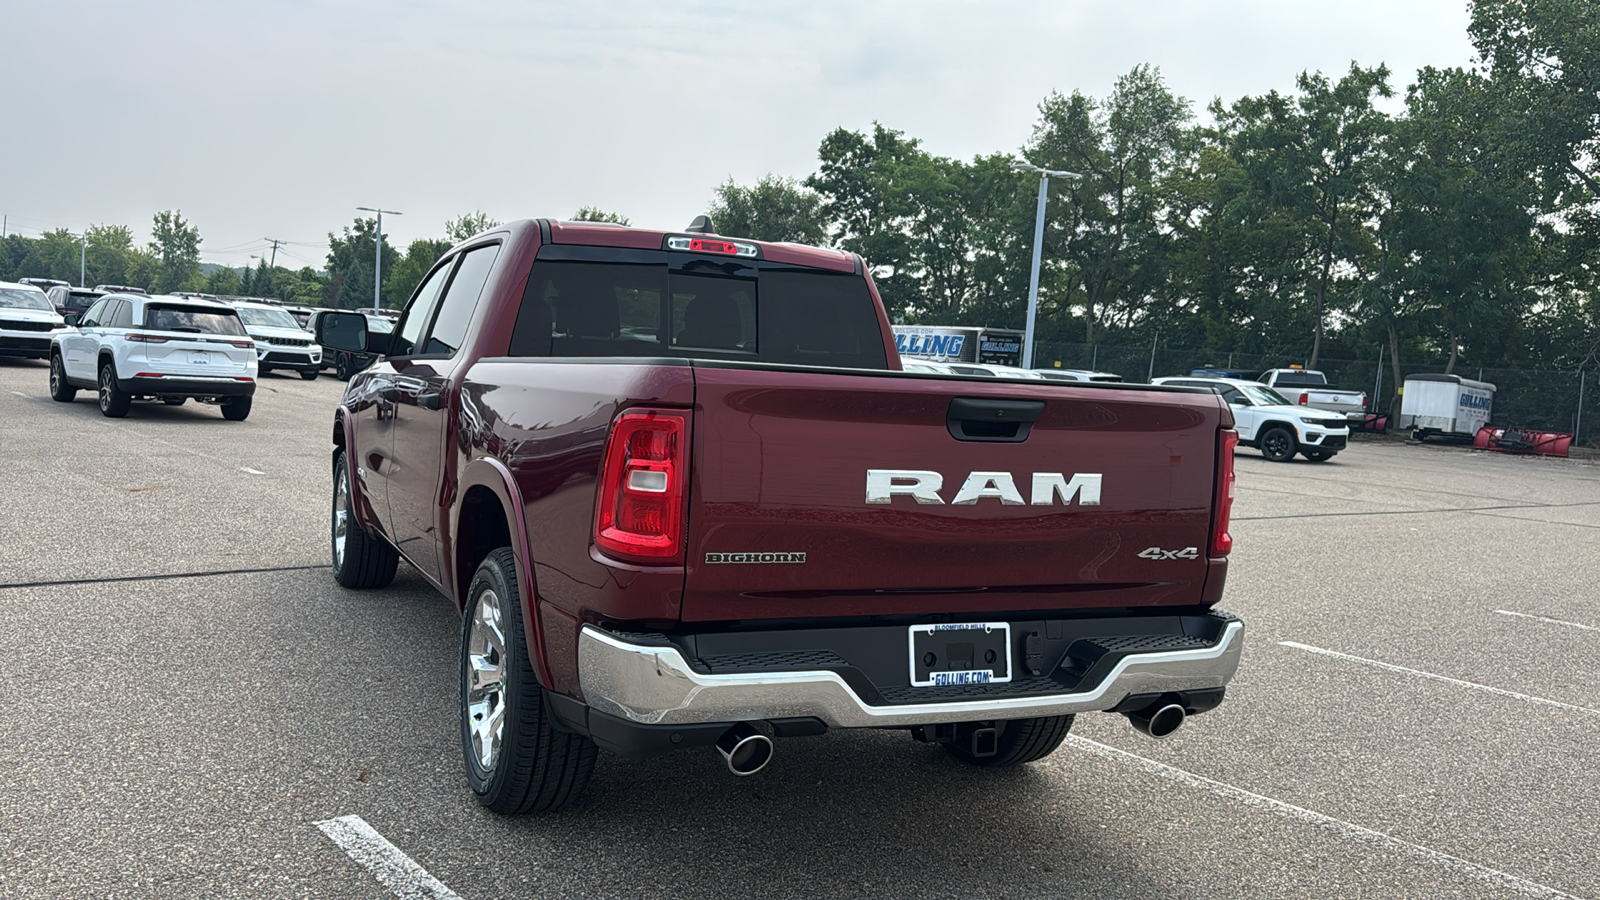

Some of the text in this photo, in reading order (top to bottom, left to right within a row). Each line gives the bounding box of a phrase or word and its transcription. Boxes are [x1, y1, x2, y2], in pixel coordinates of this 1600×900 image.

[981, 341, 1020, 352] GOLLING
[1459, 393, 1492, 410] GOLLING
[865, 469, 1103, 506] RAM
[705, 552, 807, 563] BIGHORN
[935, 671, 990, 685] GOLLING.COM
